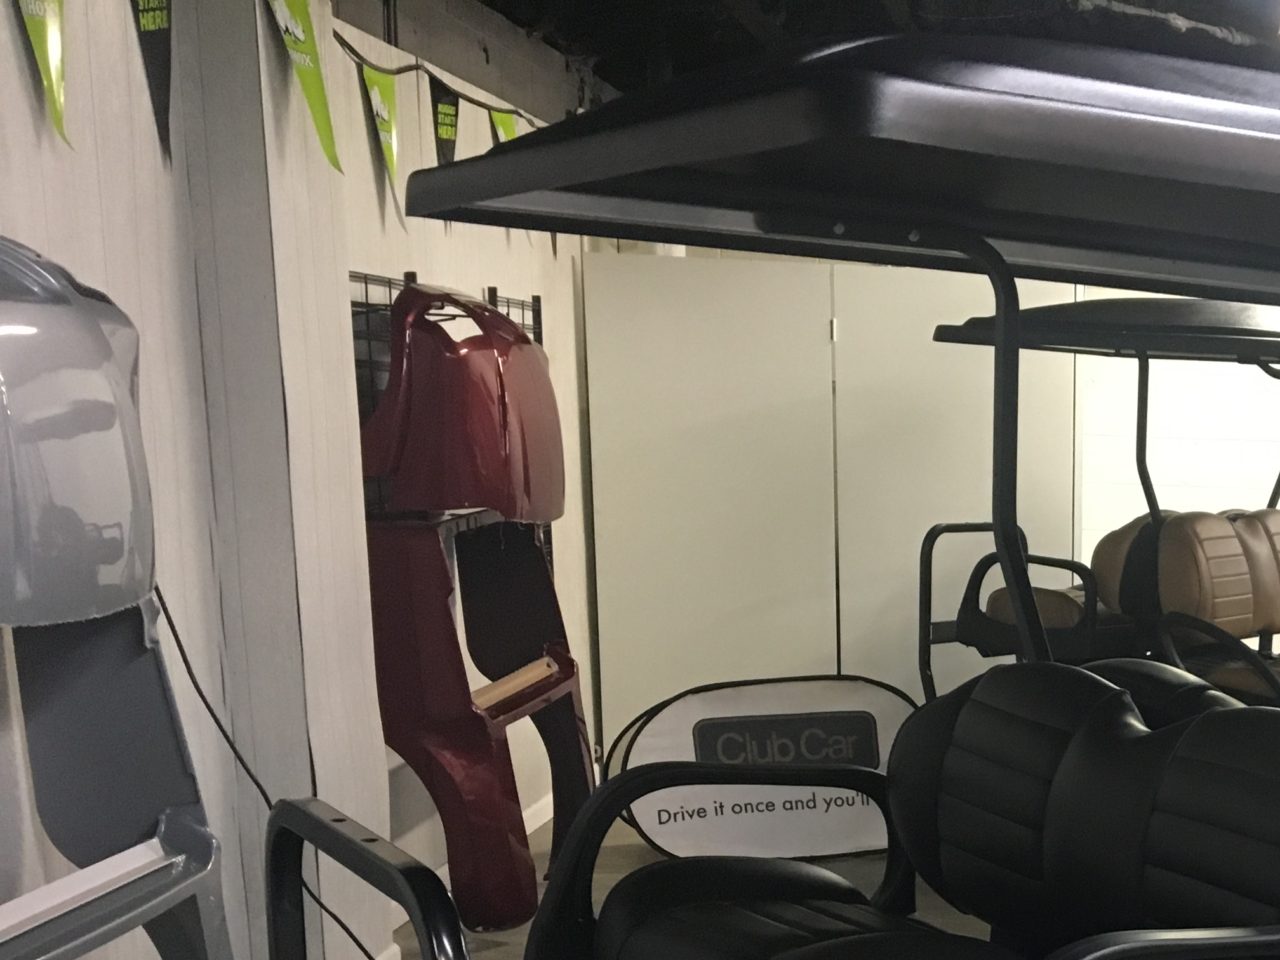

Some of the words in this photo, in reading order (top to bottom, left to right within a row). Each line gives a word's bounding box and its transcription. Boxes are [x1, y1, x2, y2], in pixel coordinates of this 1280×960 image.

[139, 10, 169, 32] HERE
[716, 731, 796, 765] Club
[801, 728, 858, 761] Car
[657, 805, 707, 825] Drive
[713, 801, 725, 816] it
[731, 801, 776, 815] once
[782, 792, 817, 811] and
[822, 792, 870, 813] you'll
